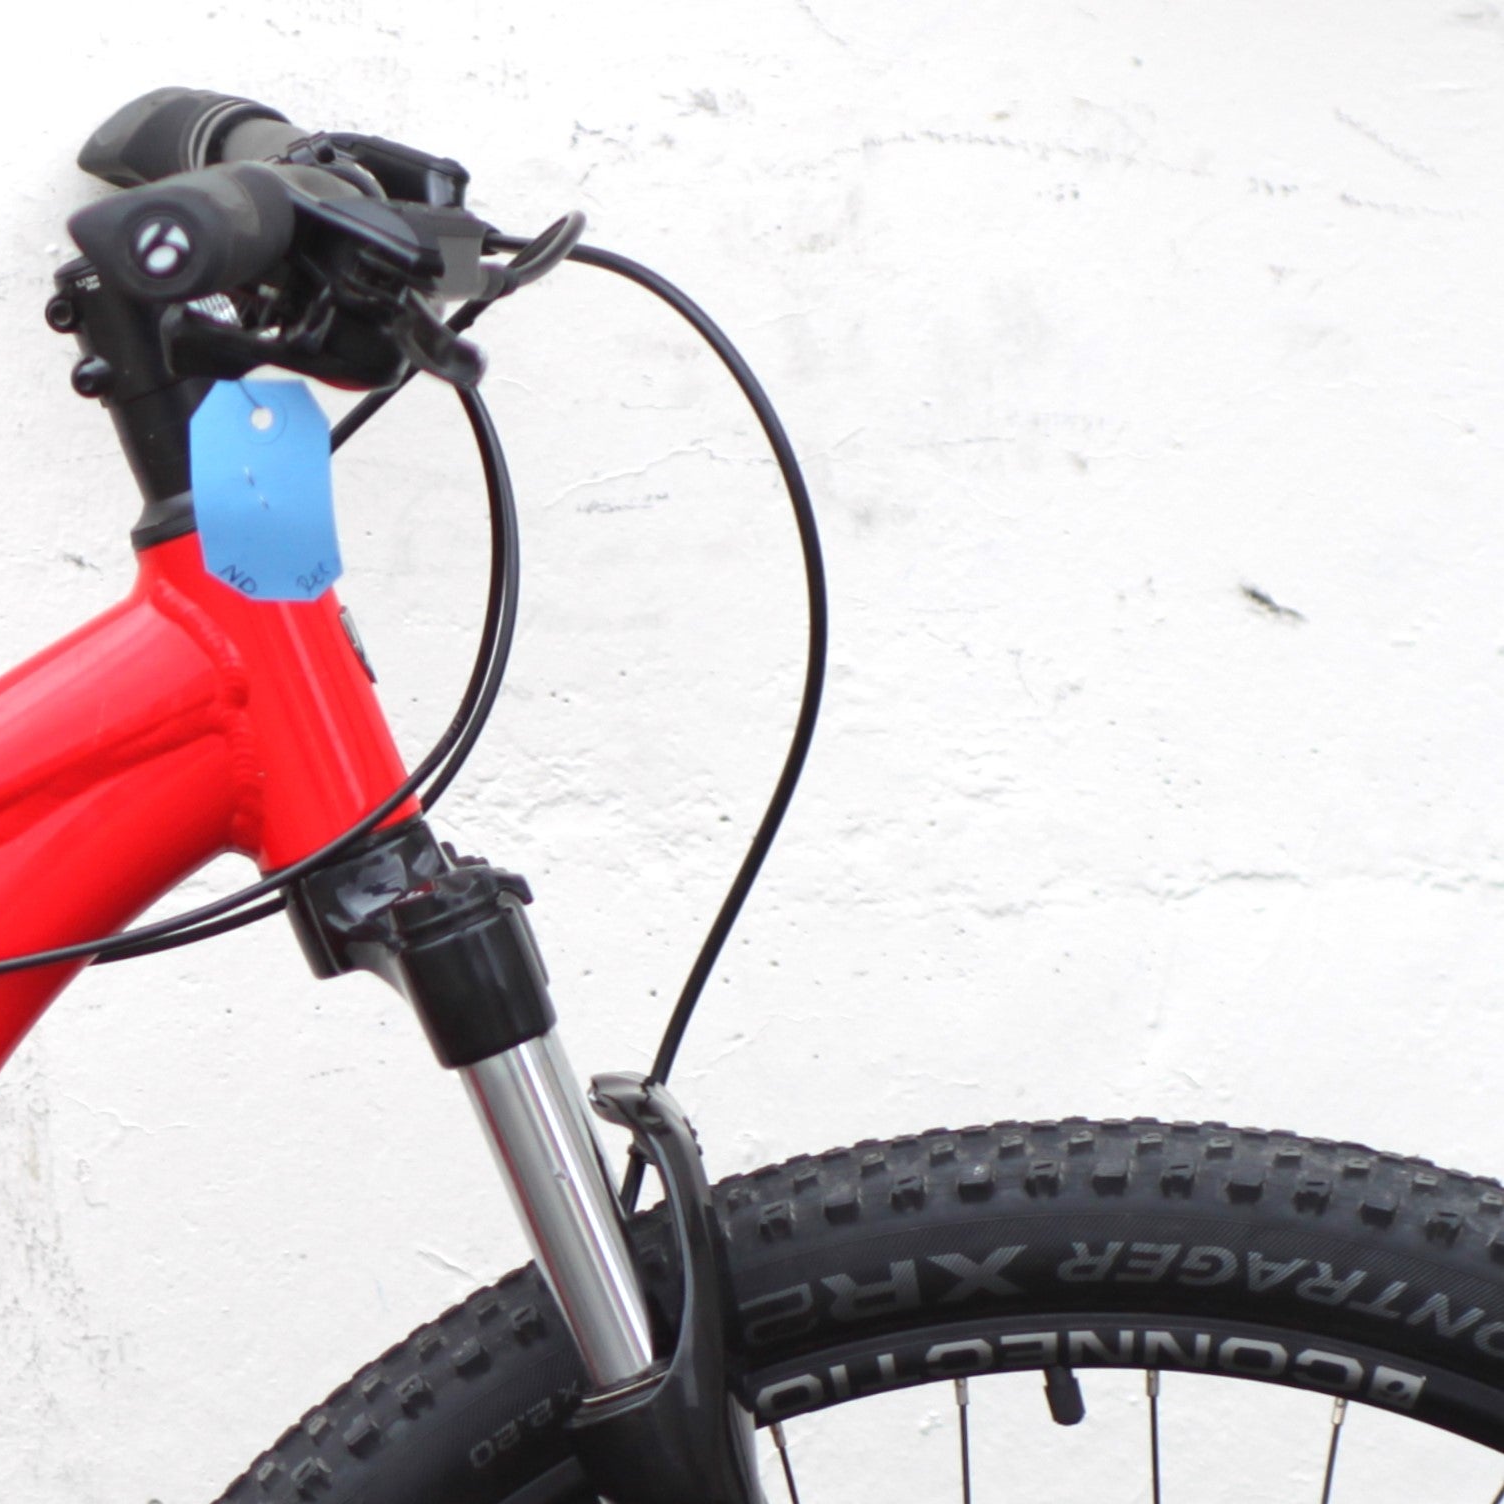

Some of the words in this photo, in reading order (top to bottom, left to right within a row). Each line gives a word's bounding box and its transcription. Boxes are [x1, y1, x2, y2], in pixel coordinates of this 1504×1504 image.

[738, 1243, 1029, 1345] XR2
[1057, 1240, 1504, 1359] ONTRAGER
[755, 1330, 1366, 1417] CONNECTIO
[469, 1397, 554, 1468] 2.20
